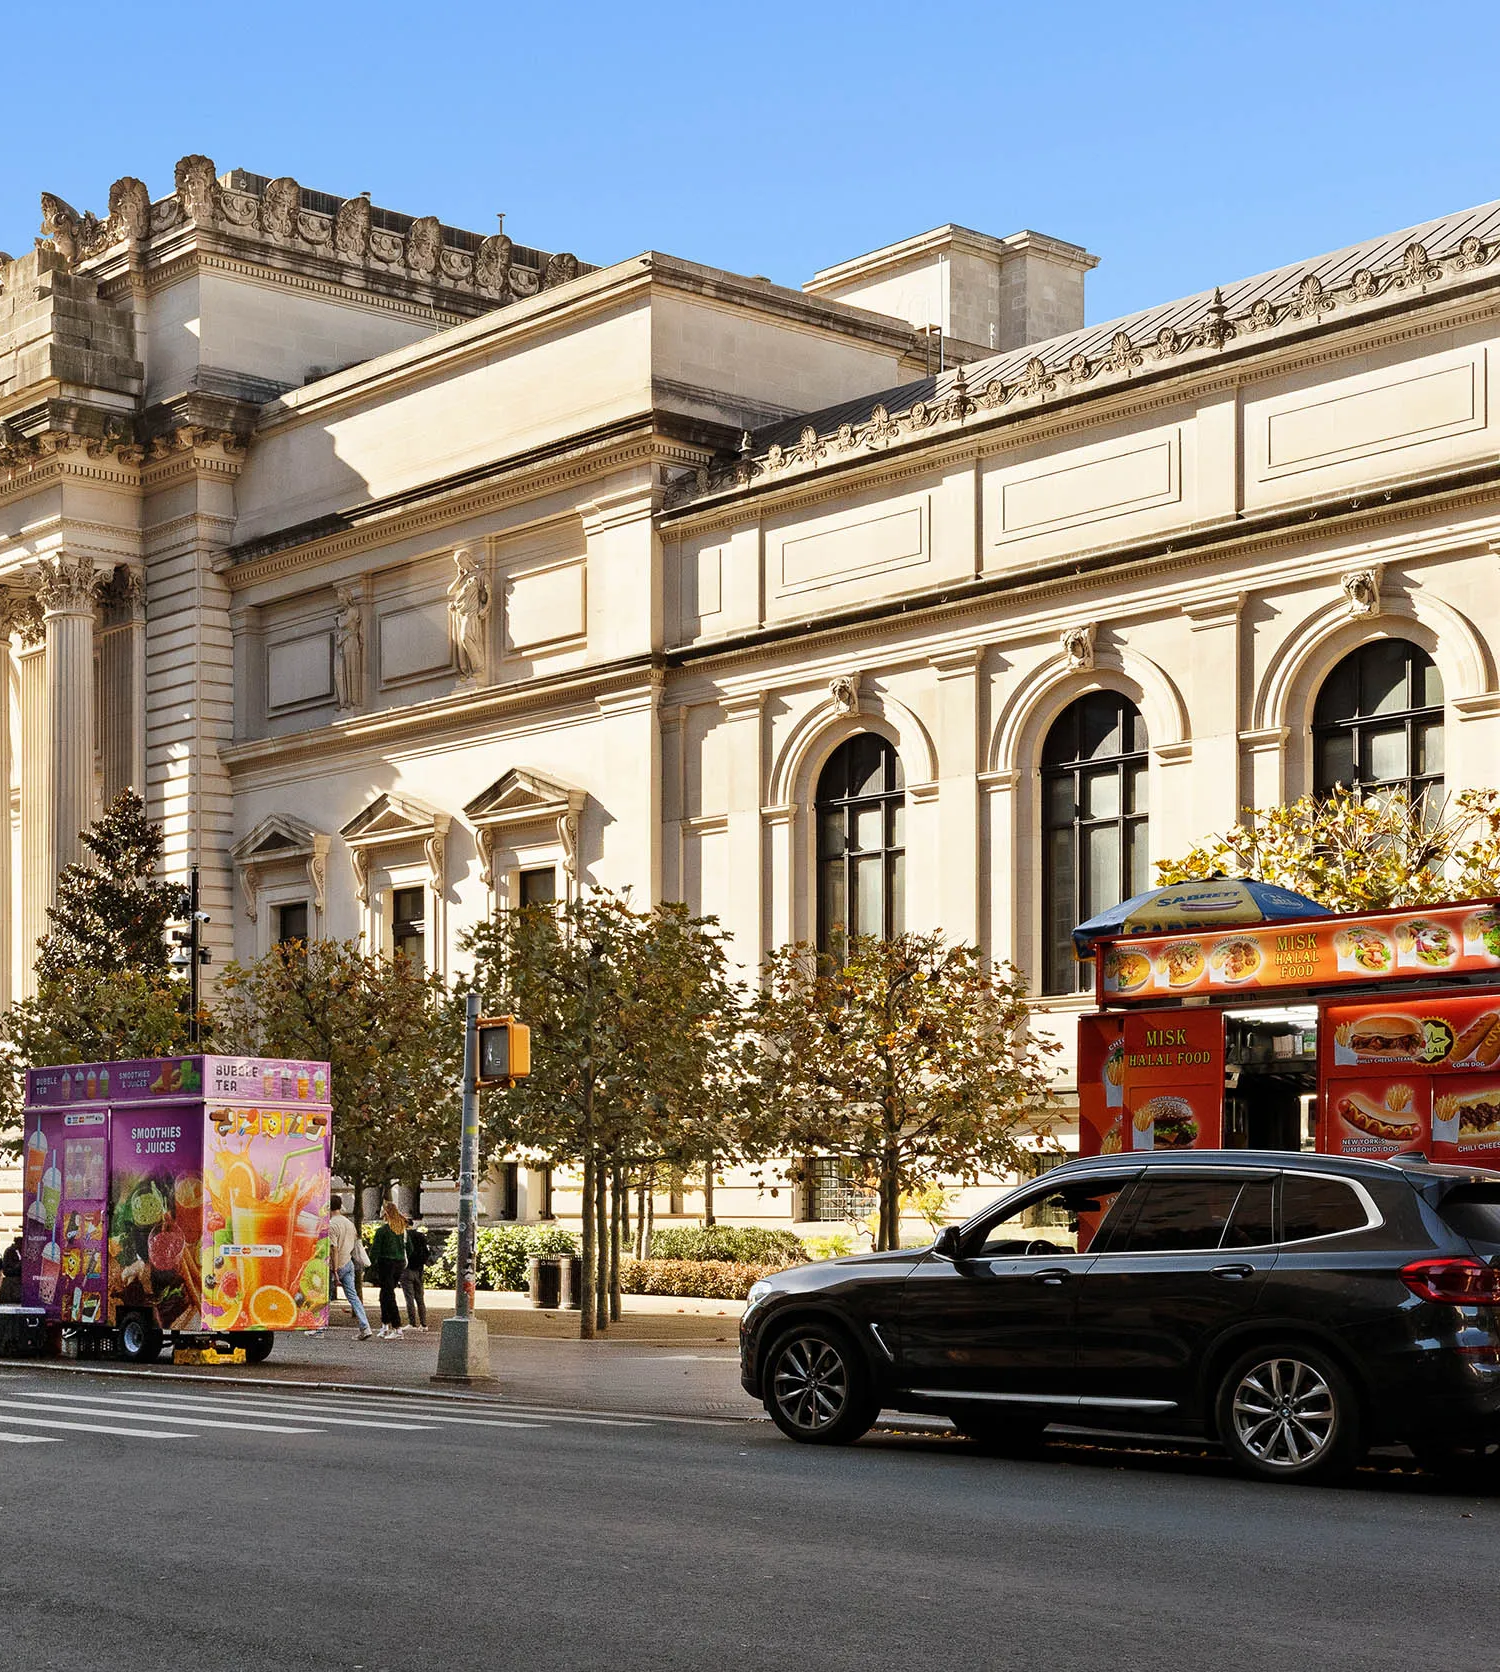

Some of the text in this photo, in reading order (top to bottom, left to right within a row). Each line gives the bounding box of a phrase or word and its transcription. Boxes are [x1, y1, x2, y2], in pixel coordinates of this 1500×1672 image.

[1157, 891, 1239, 907] SABRETT
[1276, 933, 1318, 950] MISK
[1275, 950, 1319, 964] HALAL
[1281, 964, 1314, 979] FOOD
[1146, 1029, 1187, 1047] MISK
[1129, 1051, 1210, 1067] HALAL FOOD
[36, 1076, 57, 1086] BUBBLE
[118, 1070, 151, 1080] SMOOTHIES
[36, 1086, 47, 1095] TEA
[127, 1080, 148, 1088] JUICES
[215, 1079, 237, 1092] TEA
[131, 1126, 181, 1139] SMOOTHIES
[136, 1142, 176, 1153] & JUICES
[1478, 1141, 1500, 1150] CHEES
